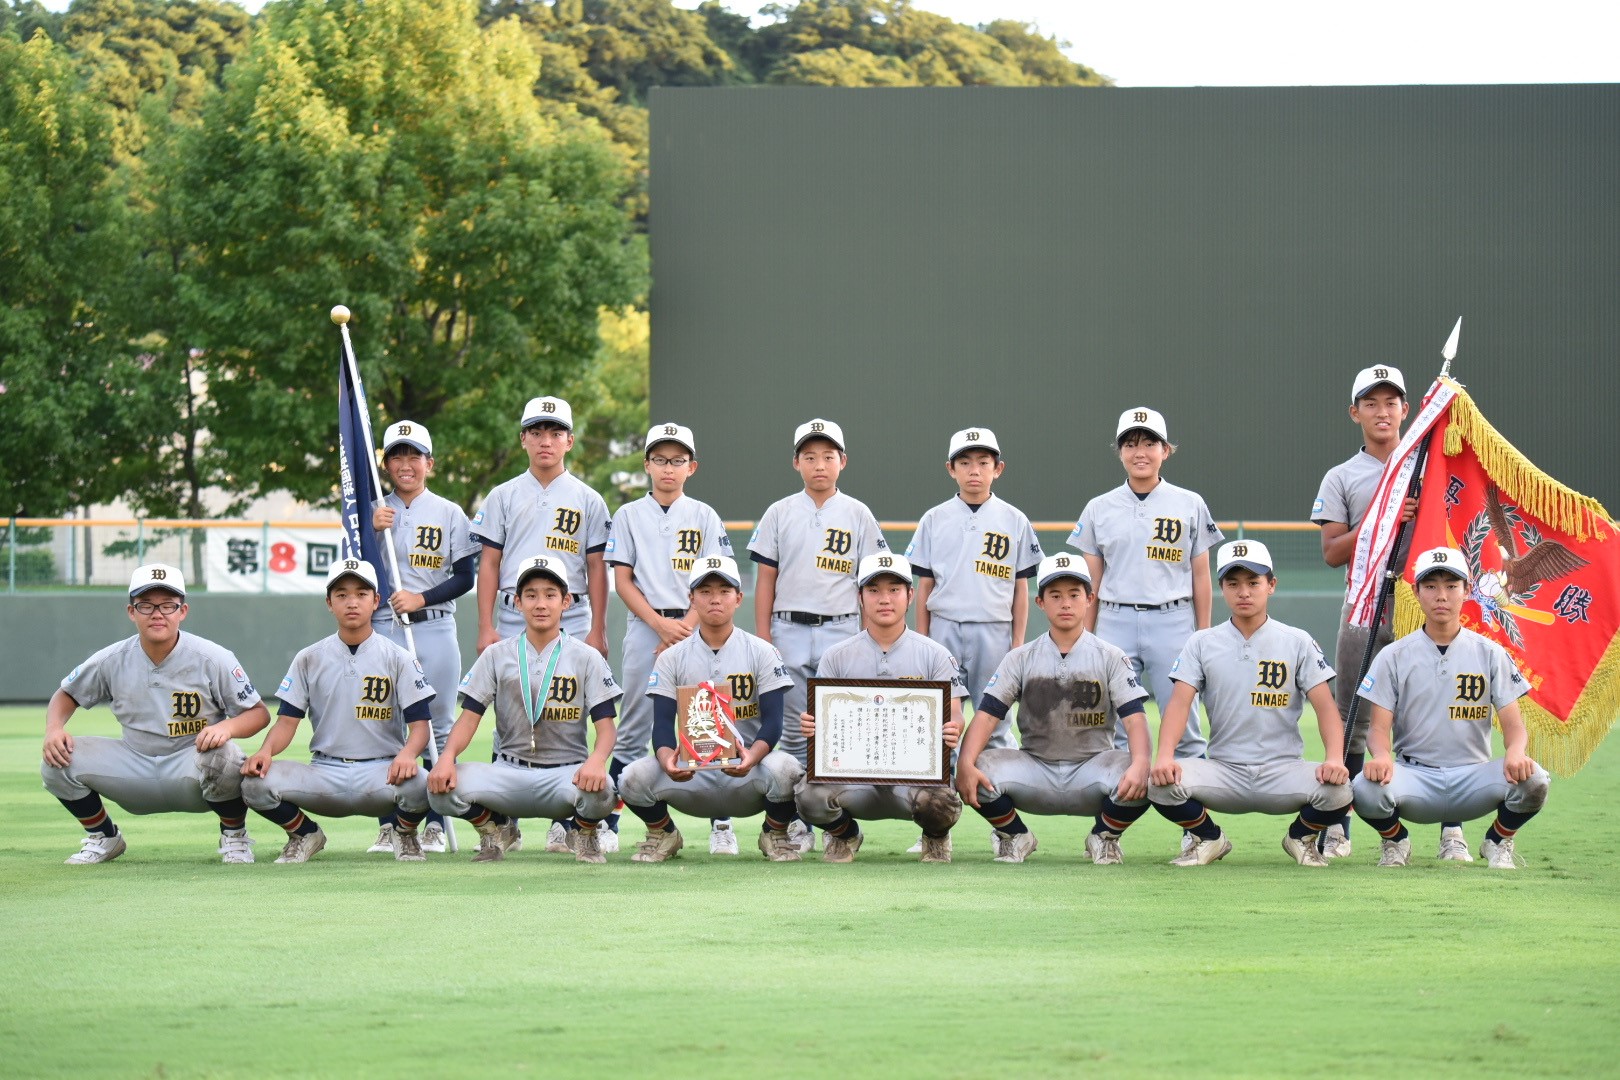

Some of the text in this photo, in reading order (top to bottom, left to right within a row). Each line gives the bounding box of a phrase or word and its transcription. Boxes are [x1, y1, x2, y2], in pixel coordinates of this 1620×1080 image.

[545, 536, 580, 554] TANABE
[226, 538, 338, 575] 第8回
[409, 553, 444, 568] TANABE
[1146, 546, 1183, 562] TANABE
[816, 555, 852, 574] TANABE
[975, 560, 1012, 579] TANABE
[1553, 584, 1593, 623] 勝
[1251, 692, 1289, 706] TANABE
[356, 706, 392, 720] TANABE
[542, 707, 581, 721] TANABE
[733, 703, 758, 719] NABE
[1449, 706, 1490, 720] TANABE
[1066, 712, 1106, 727] TANABE
[917, 714, 926, 745] 表彰状
